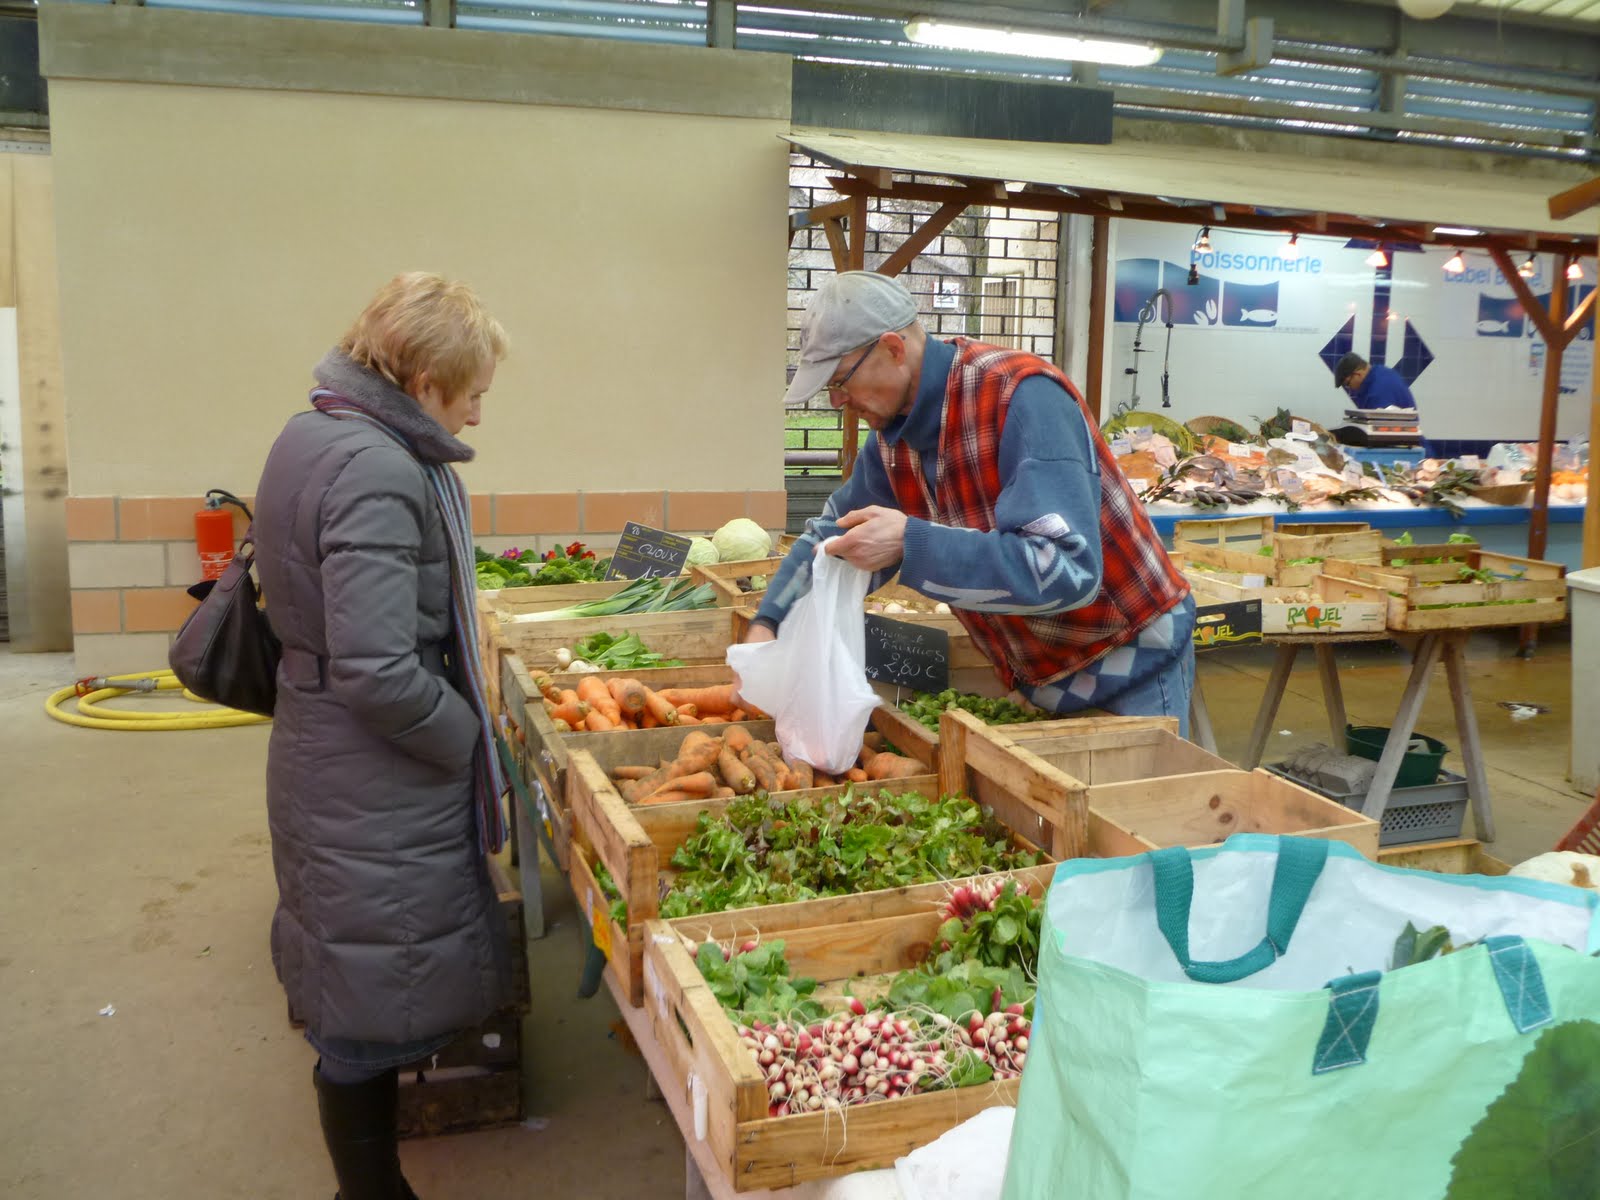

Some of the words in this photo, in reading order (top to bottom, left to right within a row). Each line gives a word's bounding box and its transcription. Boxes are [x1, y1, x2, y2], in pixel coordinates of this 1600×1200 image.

[1190, 250, 1322, 273] Poissonnerie
[1287, 605, 1343, 629] RAQUEL
[1192, 623, 1234, 645] AQUEL
